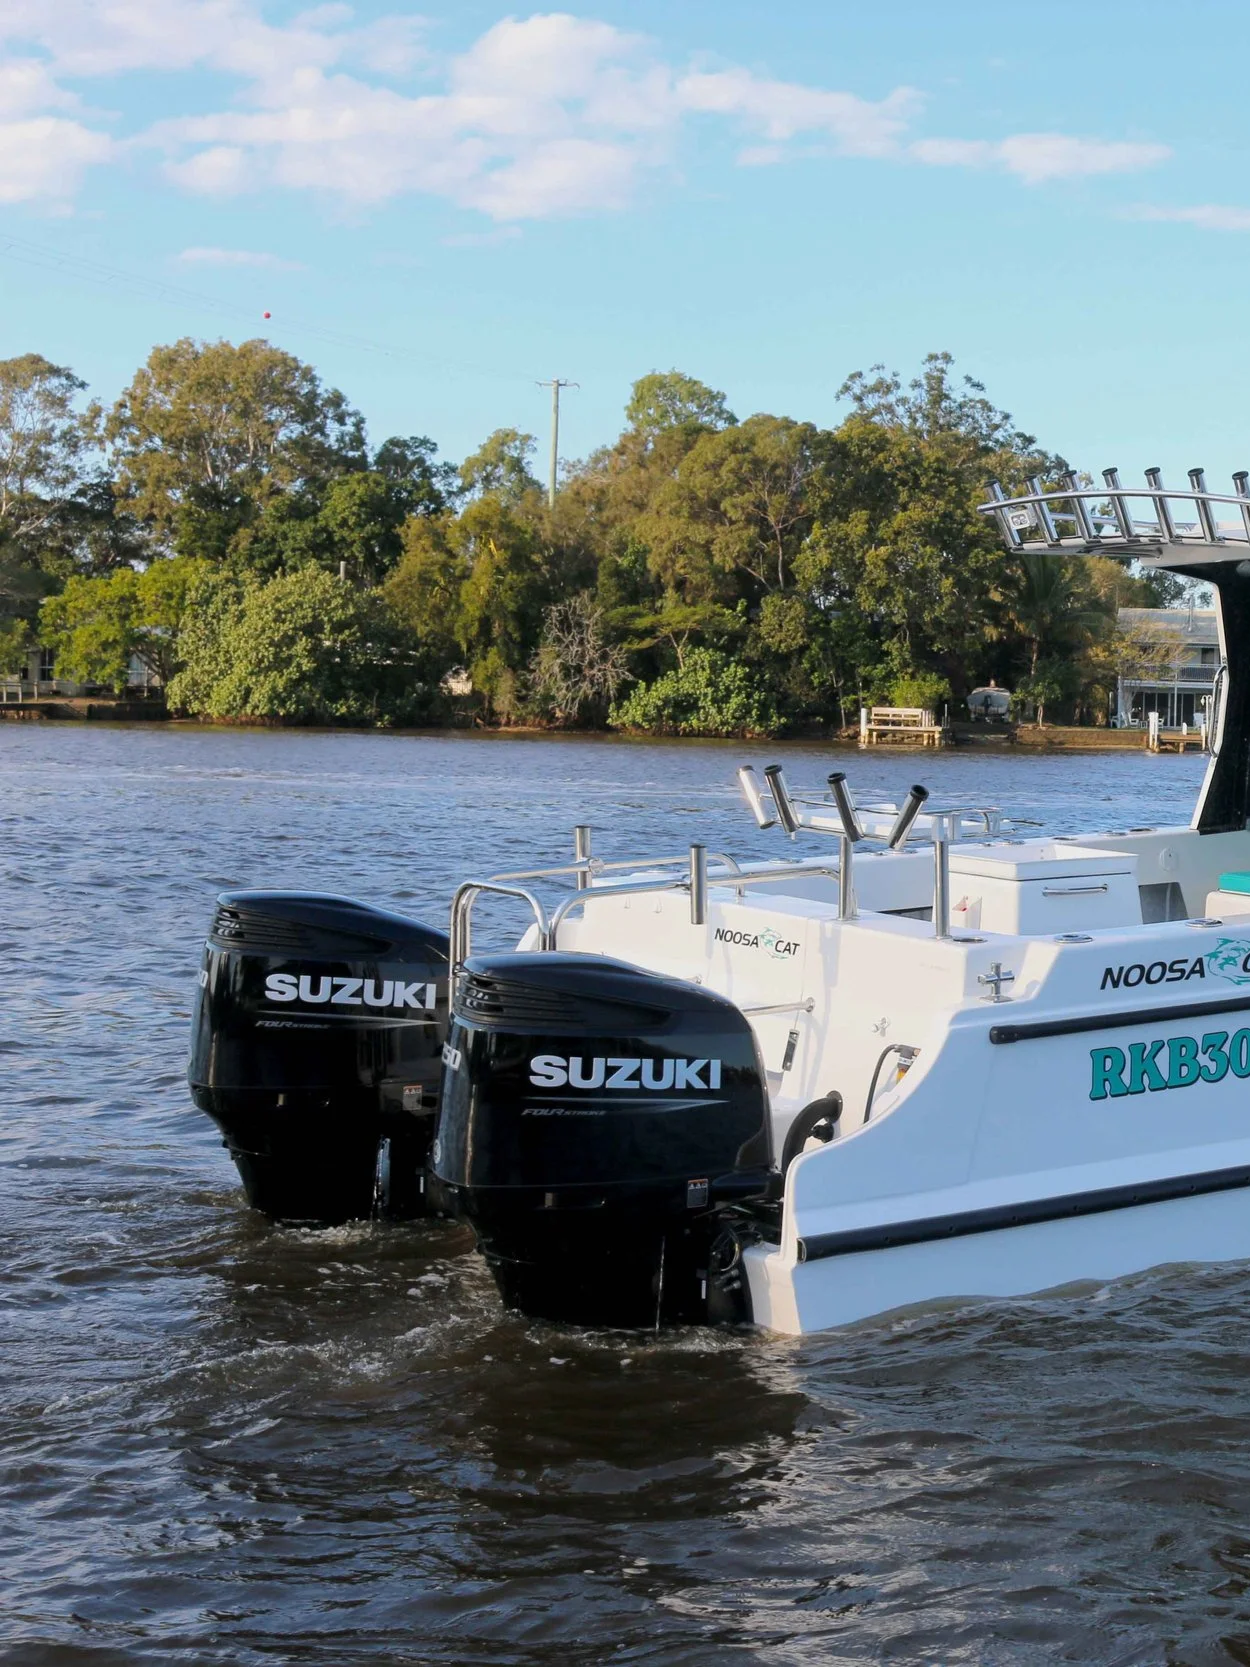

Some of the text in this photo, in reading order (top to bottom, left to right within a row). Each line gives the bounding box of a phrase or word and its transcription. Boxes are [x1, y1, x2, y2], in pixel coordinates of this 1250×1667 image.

[714, 928, 800, 956] NOOSA CAT
[1100, 956, 1206, 990] NOOSA
[264, 973, 437, 1010] SUZUKI
[529, 1055, 722, 1090] SUZUKI
